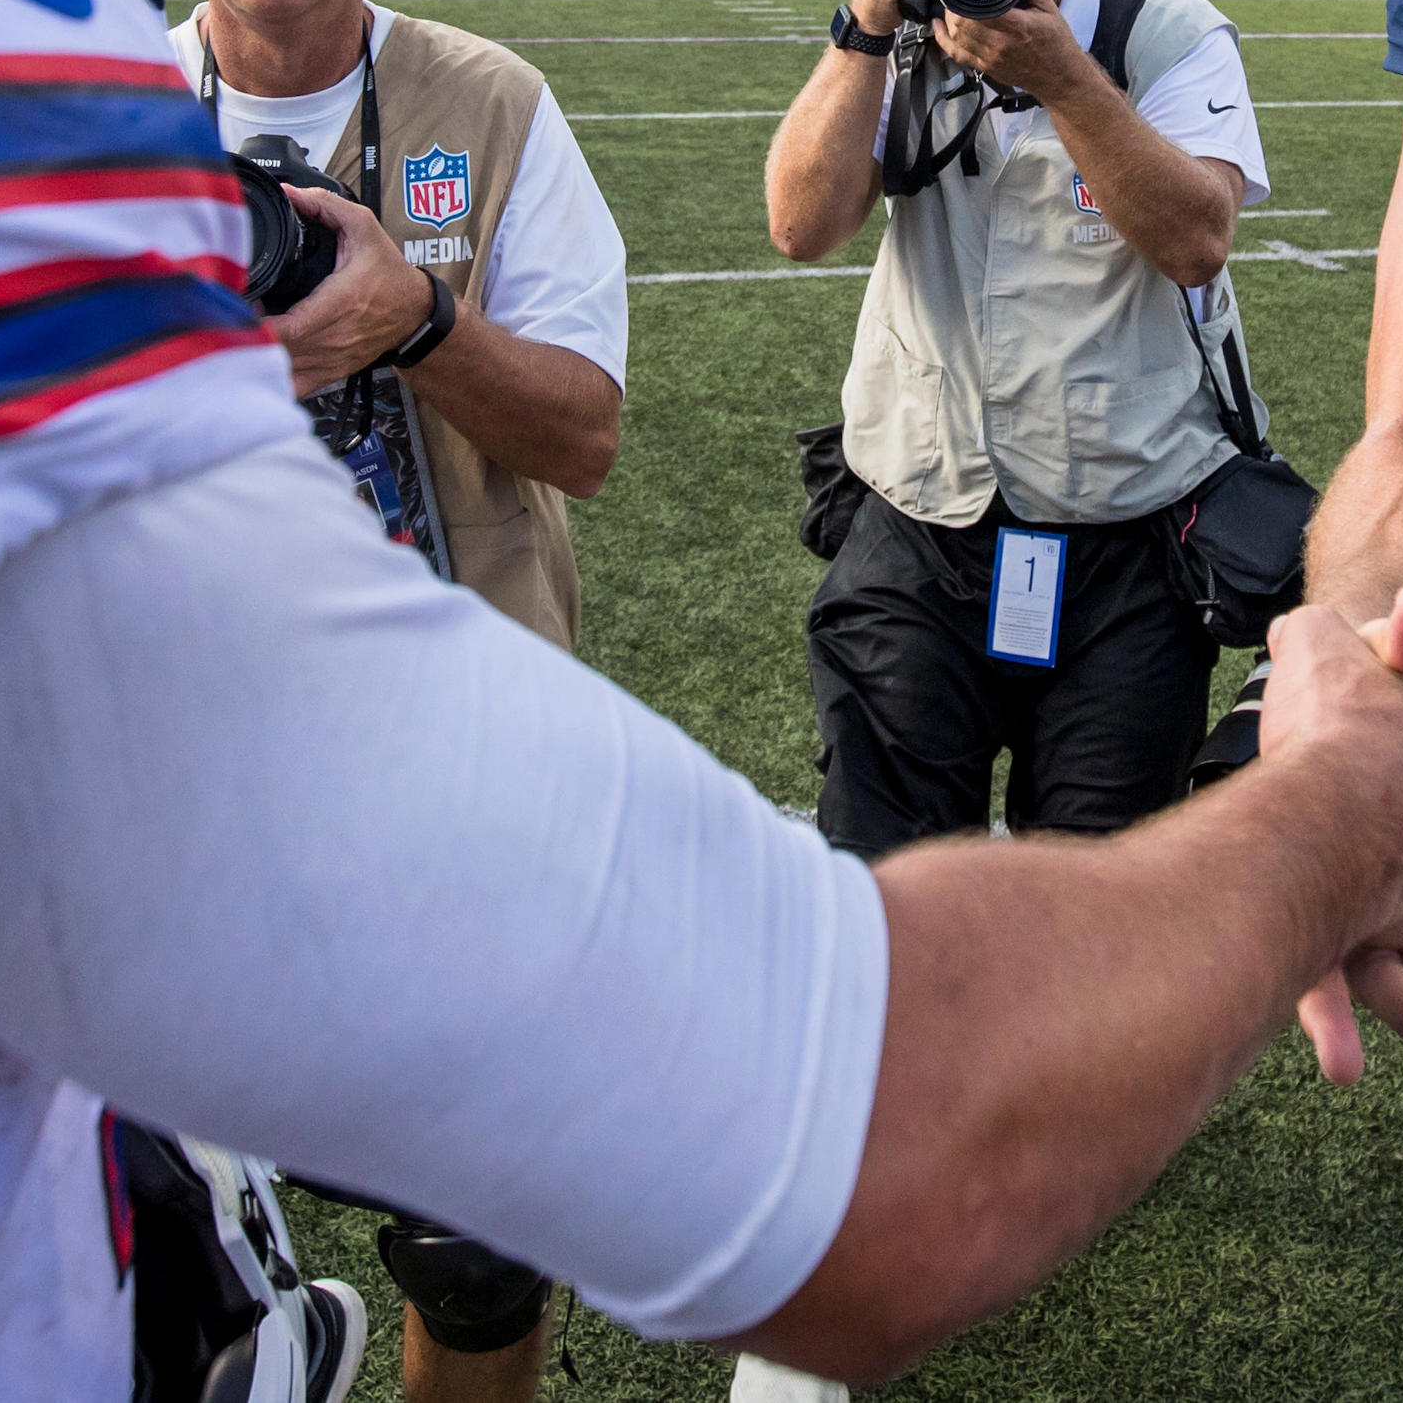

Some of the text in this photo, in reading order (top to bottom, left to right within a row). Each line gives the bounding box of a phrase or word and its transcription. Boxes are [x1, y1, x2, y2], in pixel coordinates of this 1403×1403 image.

[204, 74, 212, 98] think
[250, 157, 281, 168] anon
[365, 146, 376, 170] think
[411, 180, 464, 219] NFL
[1073, 223, 1120, 243] MEDI
[404, 235, 474, 267] MEDIA
[352, 463, 379, 478] ASON
[1024, 556, 1035, 592] 1
